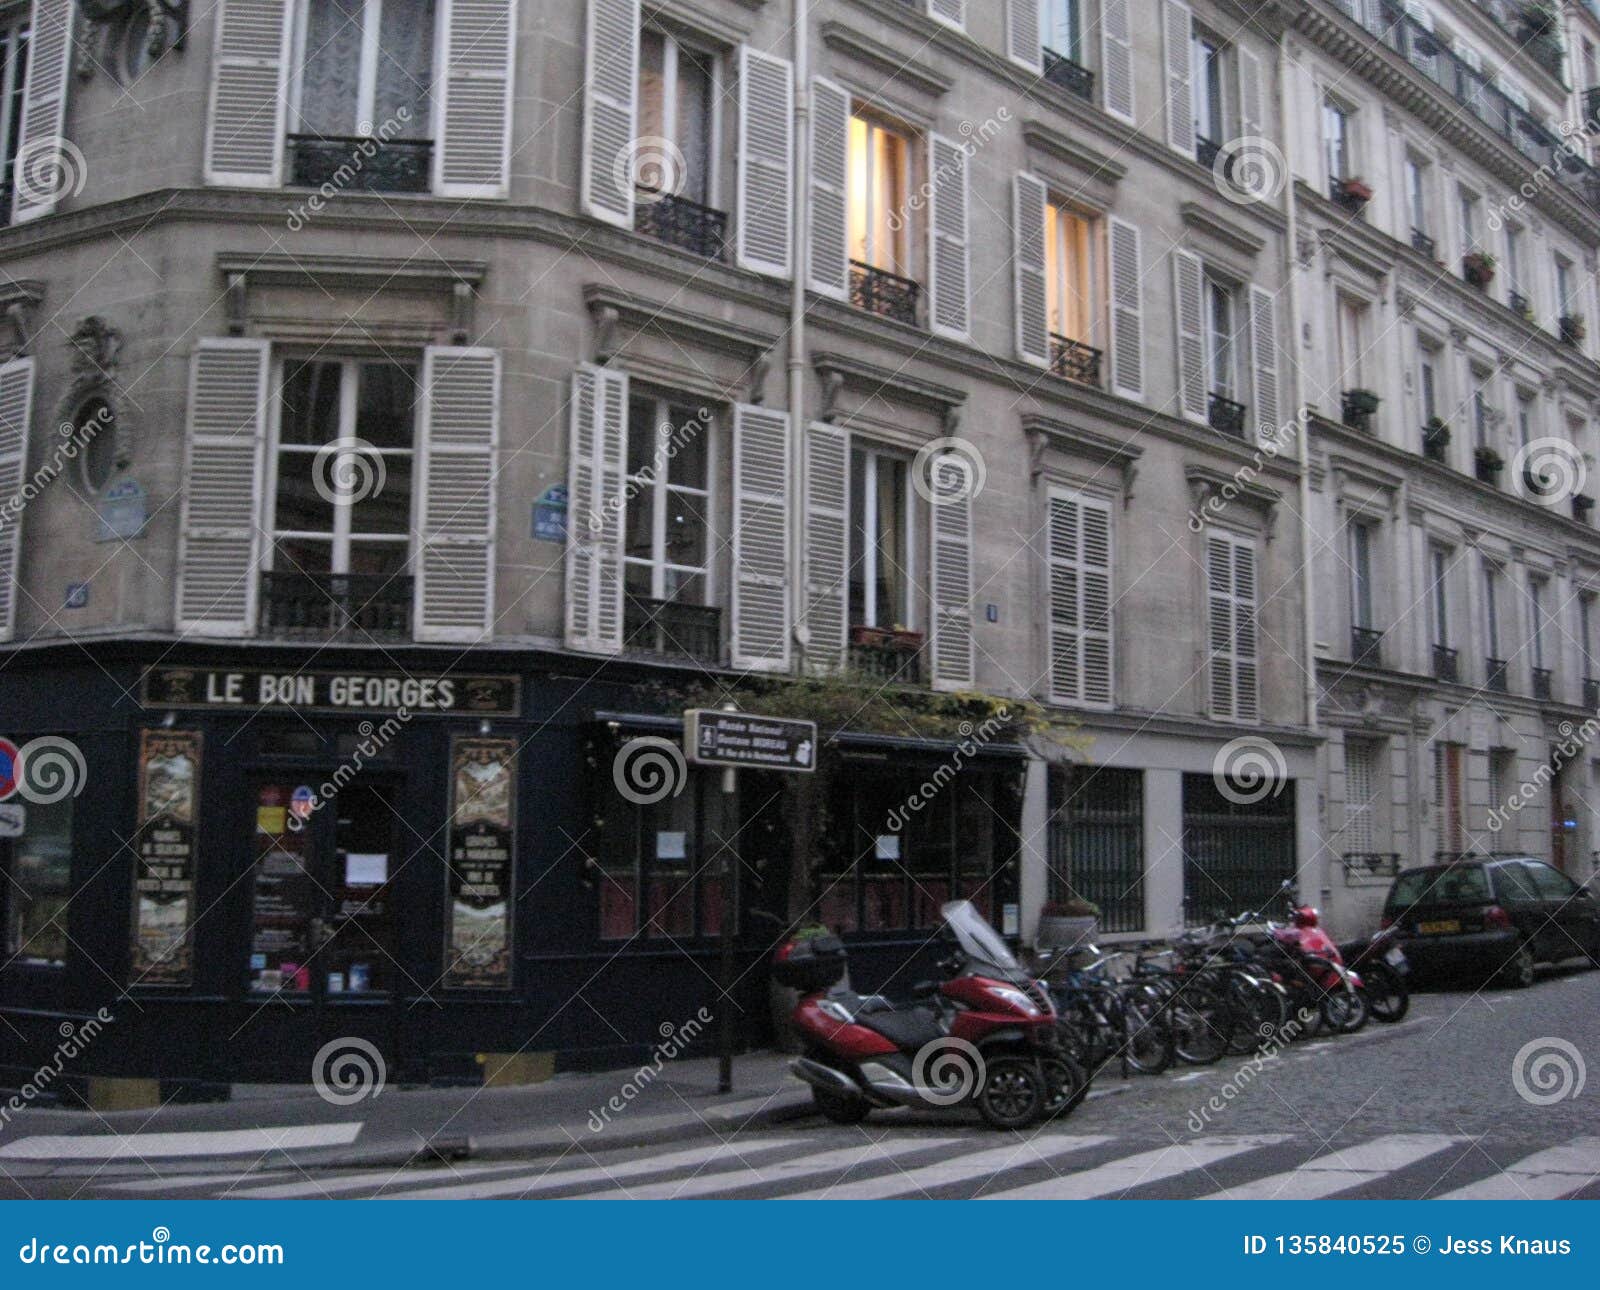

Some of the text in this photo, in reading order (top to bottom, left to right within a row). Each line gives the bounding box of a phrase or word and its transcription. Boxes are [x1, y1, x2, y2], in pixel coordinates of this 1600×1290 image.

[207, 673, 454, 708] LE BON GEORGES
